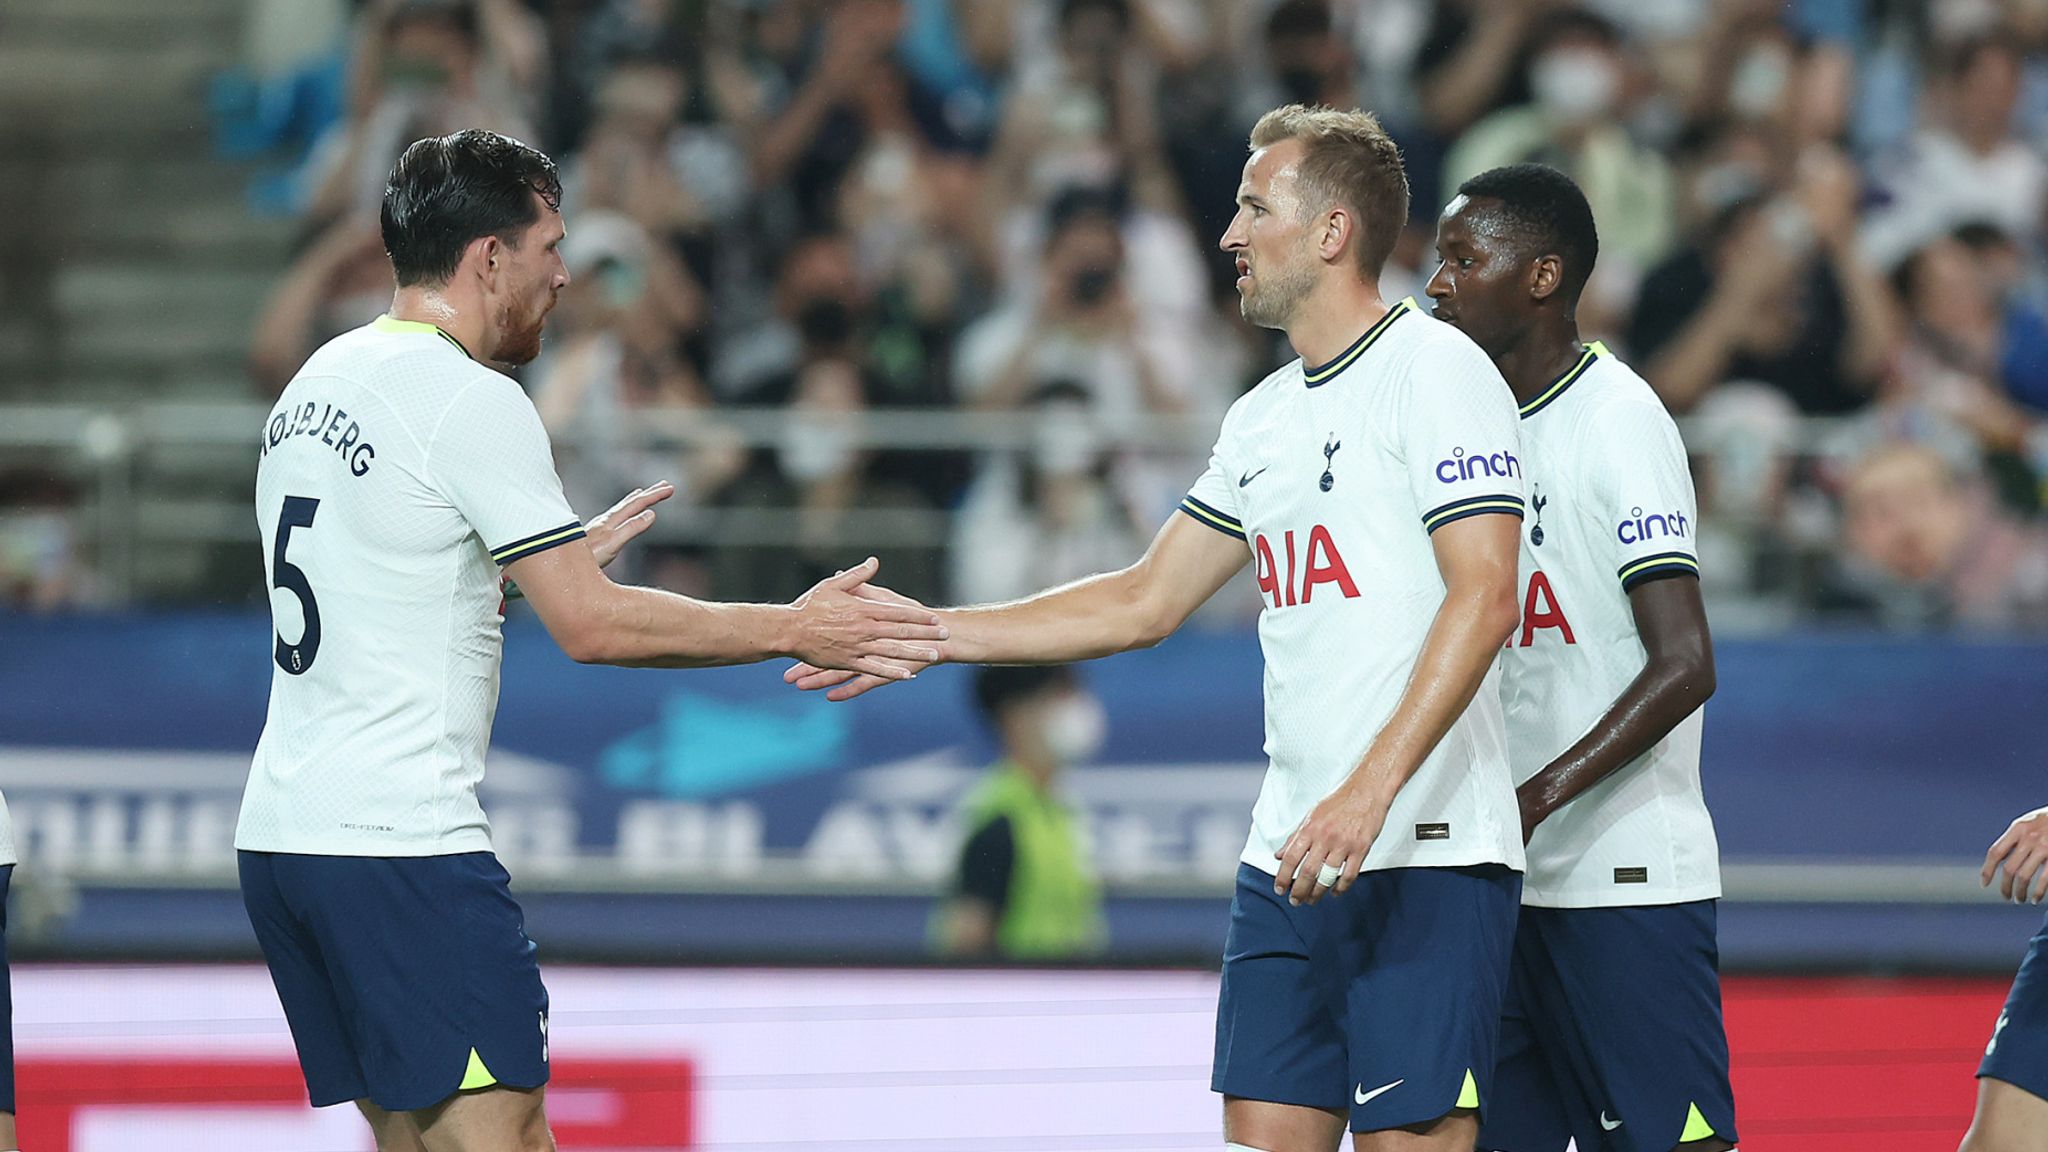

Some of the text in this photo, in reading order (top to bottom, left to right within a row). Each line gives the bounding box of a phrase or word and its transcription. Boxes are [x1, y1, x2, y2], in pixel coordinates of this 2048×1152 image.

[1436, 446, 1521, 484] cinch
[1617, 506, 1692, 545] cinch
[273, 495, 321, 676] 5
[1256, 524, 1361, 608] AIA
